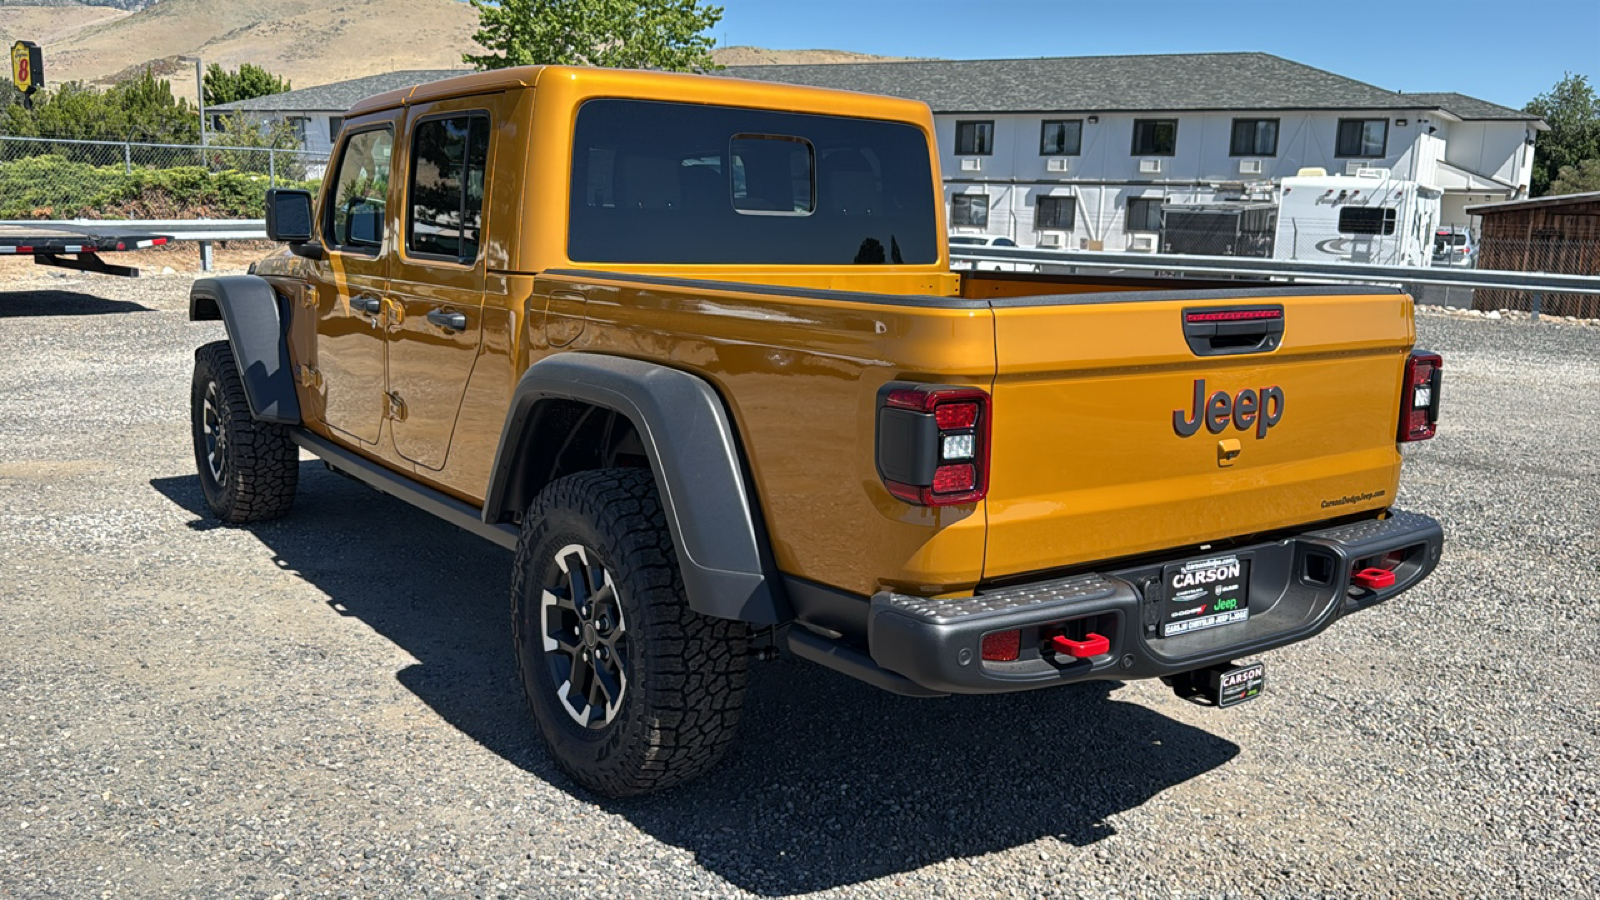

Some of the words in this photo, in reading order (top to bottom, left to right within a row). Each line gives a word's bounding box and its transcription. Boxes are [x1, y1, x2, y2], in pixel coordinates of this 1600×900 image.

[19, 58, 28, 81] 8
[1172, 378, 1285, 440] Jeep
[1173, 564, 1240, 587] CARSON
[1214, 598, 1237, 611] Jeep
[1223, 668, 1262, 687] CARSON
